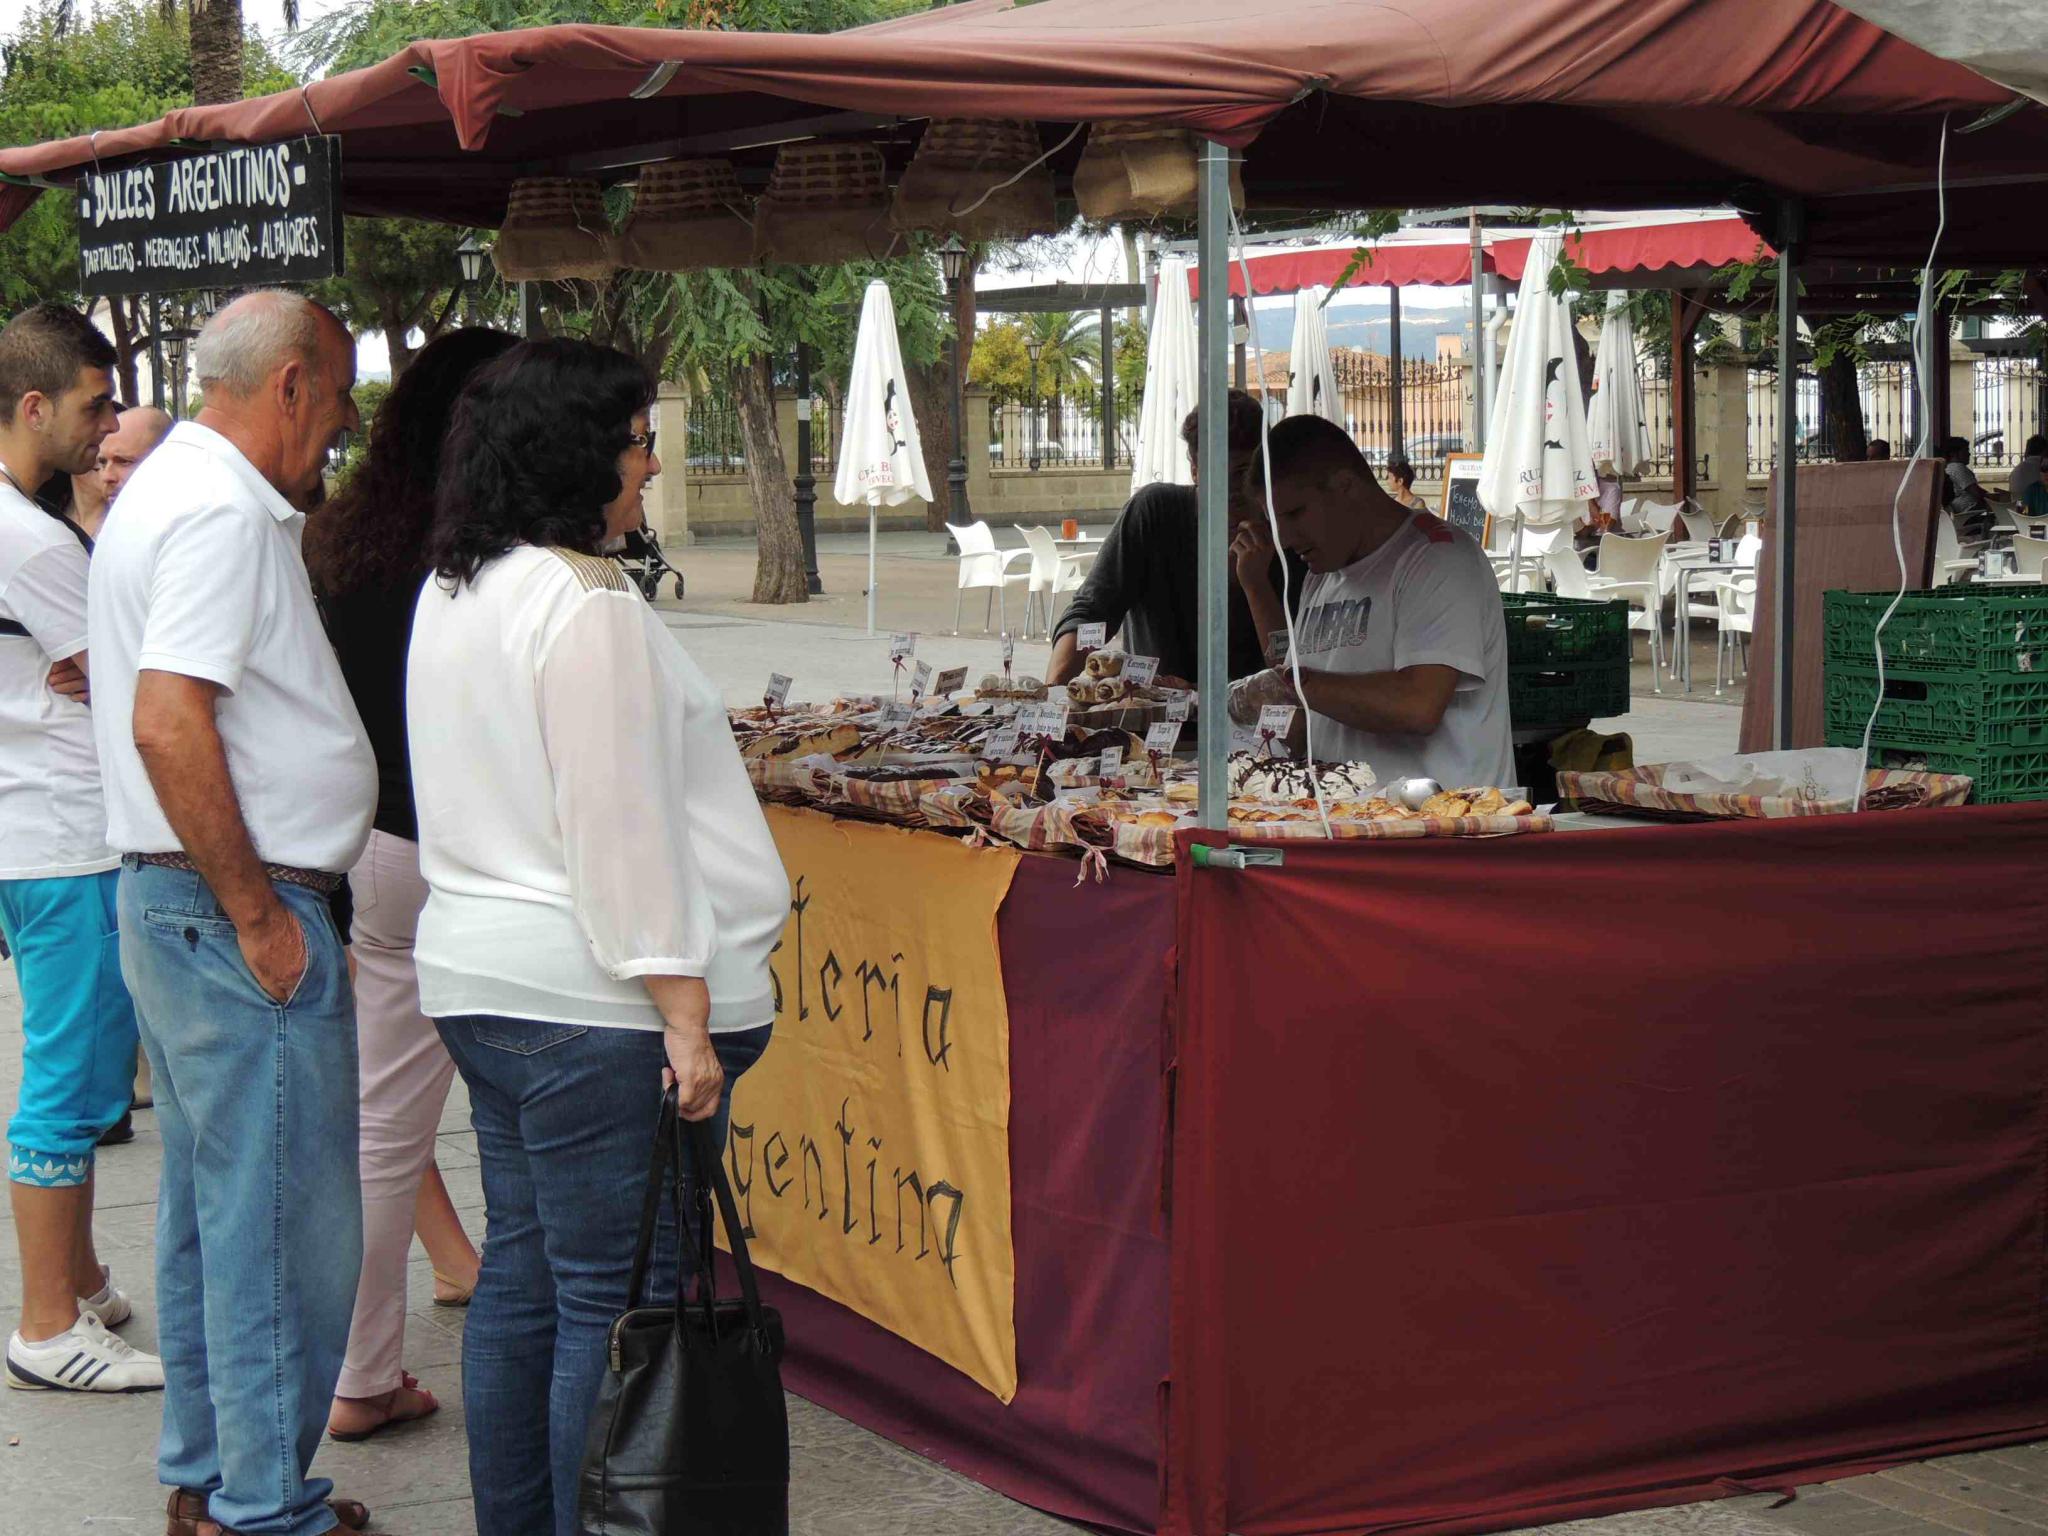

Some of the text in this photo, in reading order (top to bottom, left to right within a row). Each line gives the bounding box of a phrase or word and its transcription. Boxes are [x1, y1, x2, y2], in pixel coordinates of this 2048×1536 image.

[94, 144, 291, 228] DULCES ARGENTINOS
[83, 212, 319, 278] TARTALETAS MERENGUES MILHOJAS ALFAJORES
